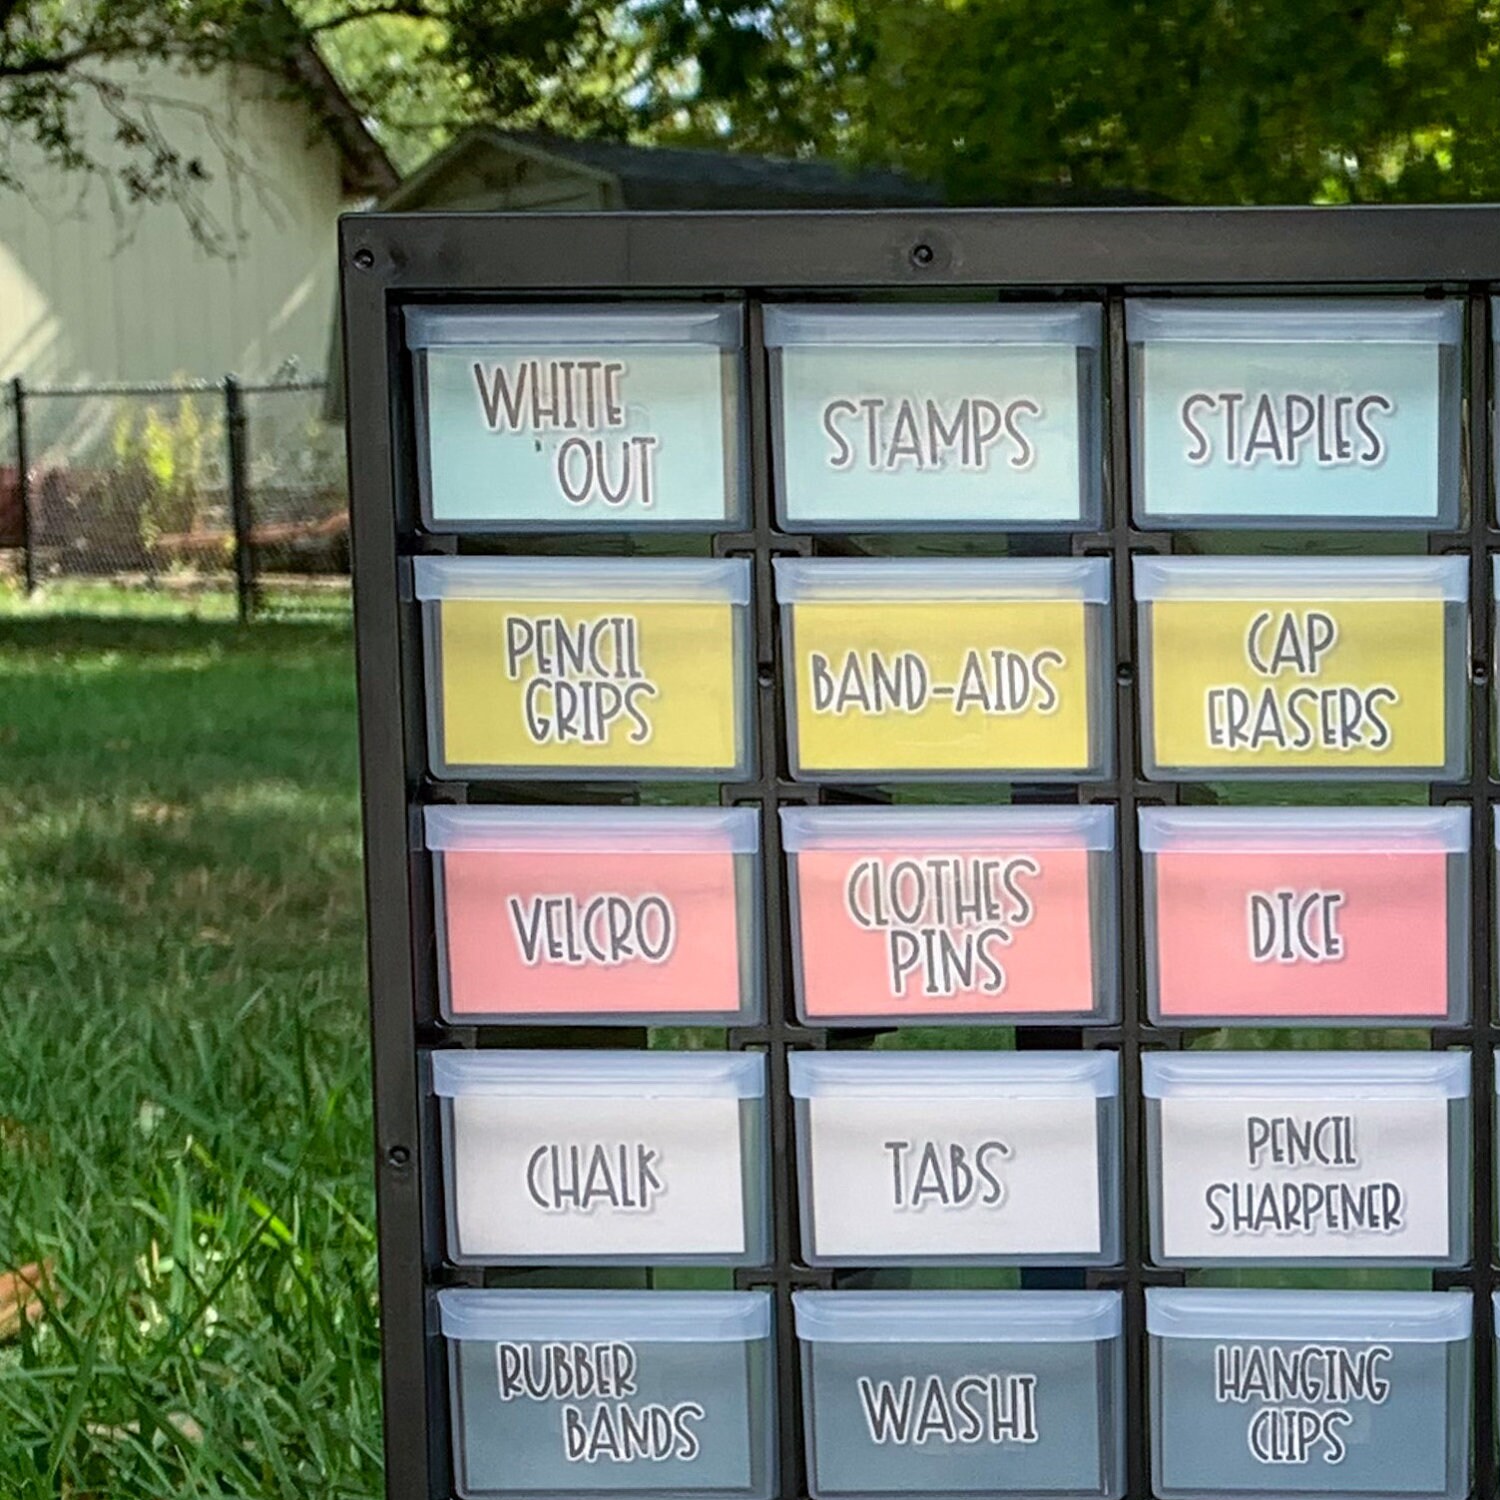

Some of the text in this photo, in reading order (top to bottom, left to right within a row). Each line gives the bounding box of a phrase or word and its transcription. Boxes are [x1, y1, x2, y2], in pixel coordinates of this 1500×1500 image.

[474, 361, 623, 430] WHITE
[823, 399, 1039, 469] STAMPS
[1182, 394, 1391, 462] STAPLES
[558, 439, 656, 504] OUT
[506, 616, 642, 679] PENCIL
[1248, 612, 1335, 674] CAP
[526, 679, 656, 741] GRIPS
[811, 650, 1064, 712] BAND-AIDS
[1209, 688, 1396, 748] ERASERS
[848, 859, 1038, 925] CLOTHES
[511, 898, 671, 962] VELCRO
[1252, 893, 1341, 959] DICE
[892, 929, 1011, 994] PINS
[1248, 1116, 1357, 1166] PENCIL
[527, 1145, 662, 1208] CHALK
[884, 1141, 1009, 1205] TABS
[1206, 1182, 1401, 1231] SHARPENER
[501, 1344, 635, 1398] RUBBER
[1217, 1348, 1390, 1400] HANGING
[566, 1405, 702, 1459] BANDS
[861, 1377, 1036, 1442] WASHI
[1250, 1411, 1351, 1462] CLIPS
